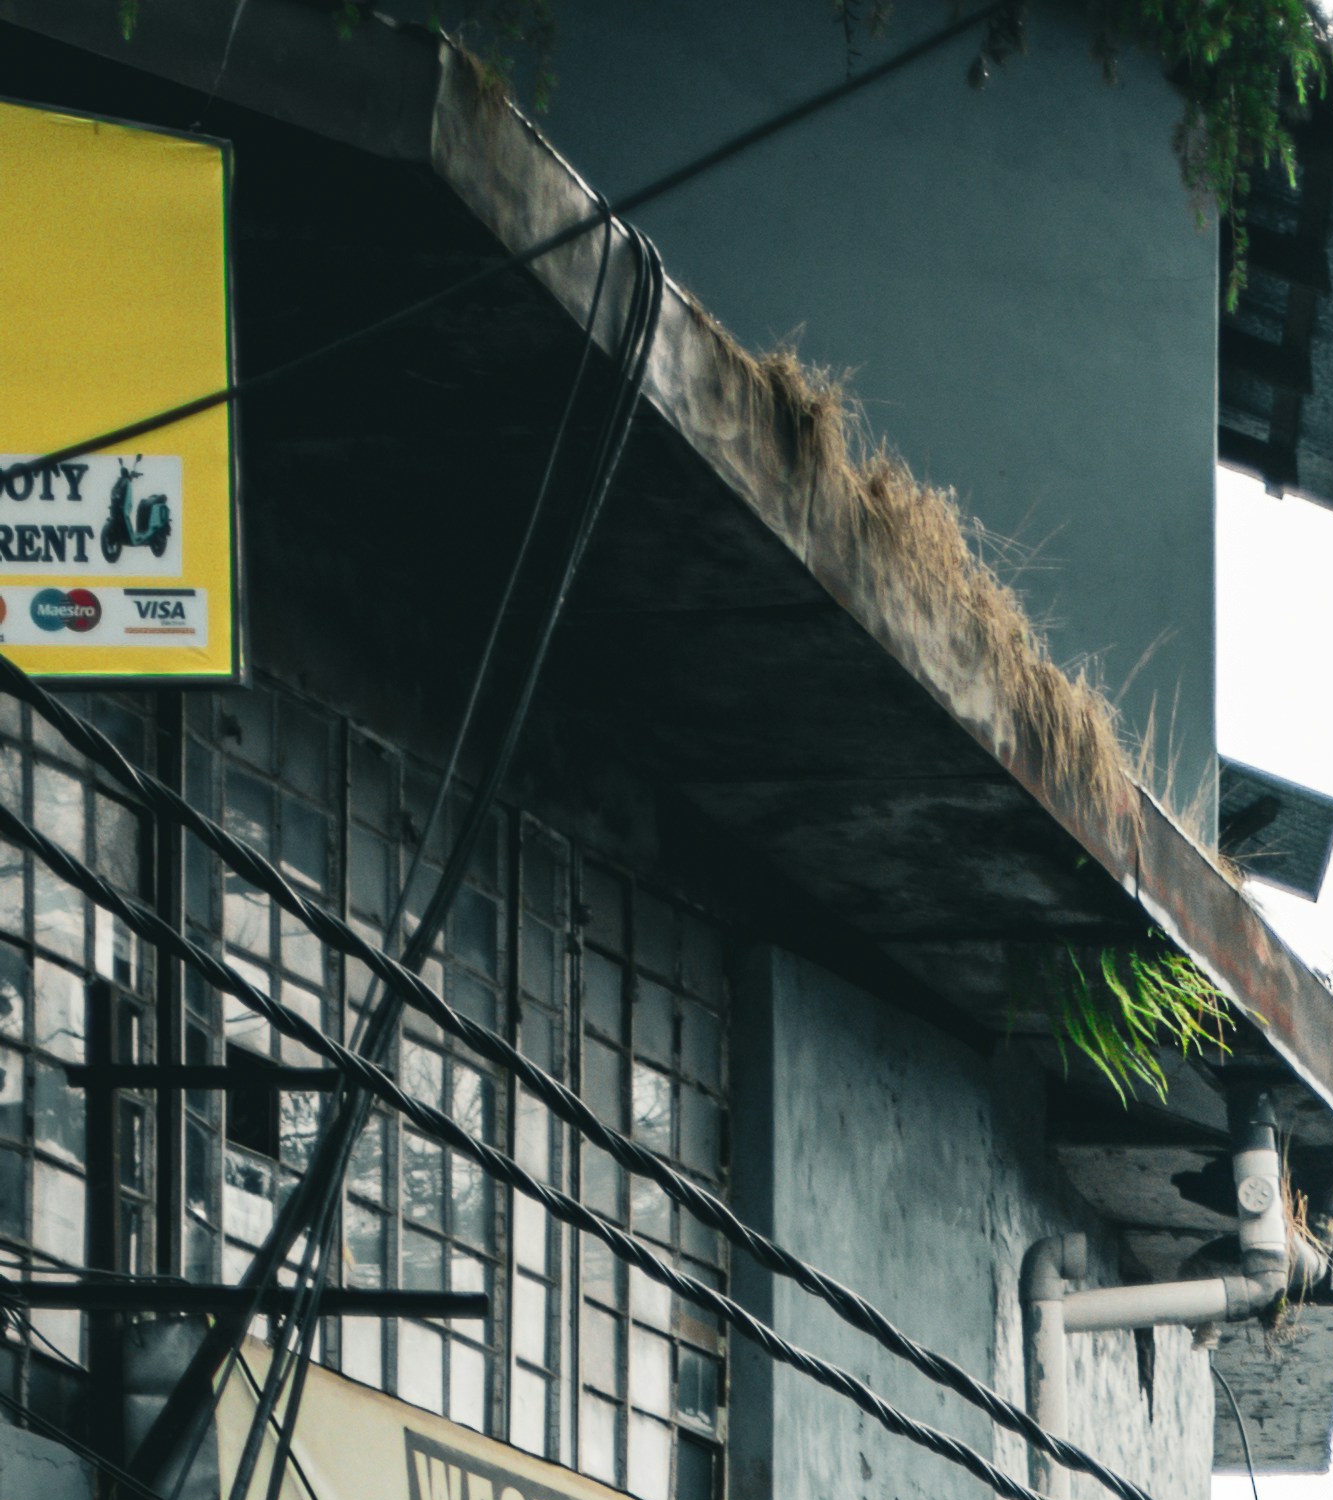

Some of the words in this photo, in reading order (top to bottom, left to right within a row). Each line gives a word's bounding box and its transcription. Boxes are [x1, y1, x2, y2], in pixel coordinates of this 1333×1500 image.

[0, 463, 89, 501] OTY
[37, 604, 96, 617] Maestro
[135, 601, 186, 619] VISA
